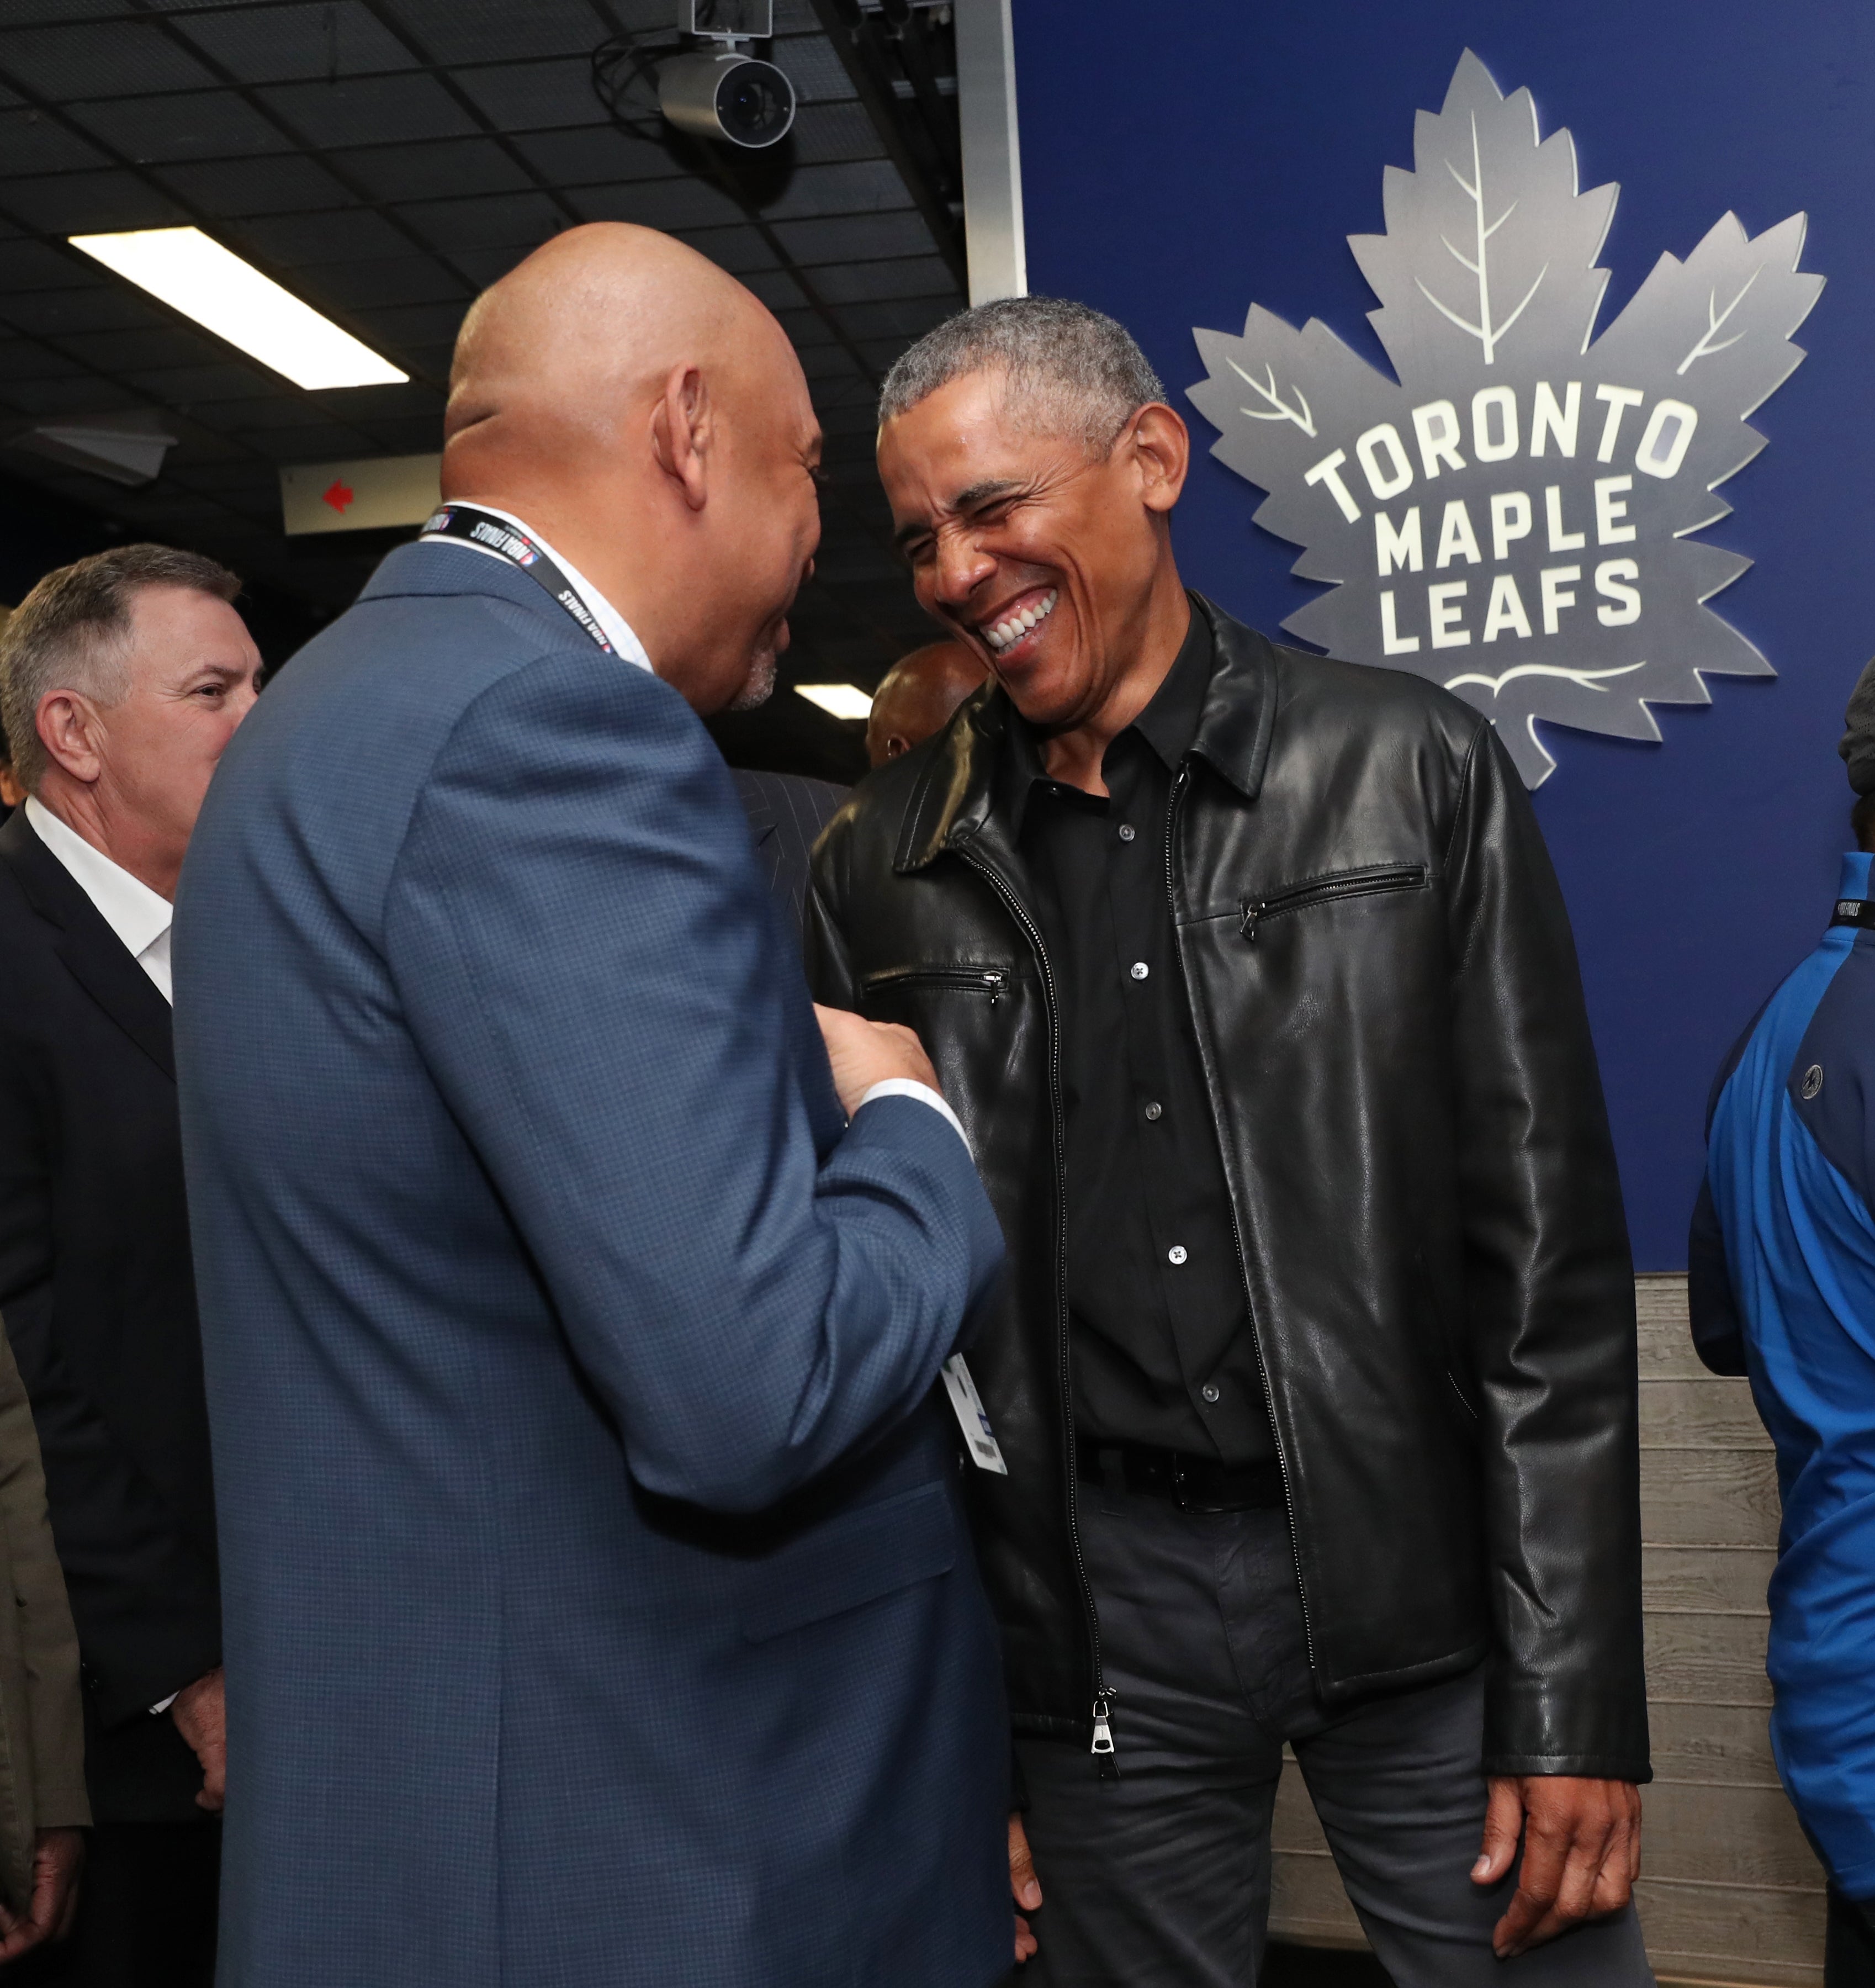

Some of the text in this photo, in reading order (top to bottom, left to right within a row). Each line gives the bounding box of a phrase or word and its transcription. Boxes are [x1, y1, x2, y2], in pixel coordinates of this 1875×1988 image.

[1304, 382, 1698, 524] TORONTO
[470, 522, 511, 548] FINALS
[501, 536, 531, 561] NBA
[1375, 475, 1636, 577] MAPLE
[558, 590, 592, 625] FINALS
[1380, 558, 1642, 655] LEAFS
